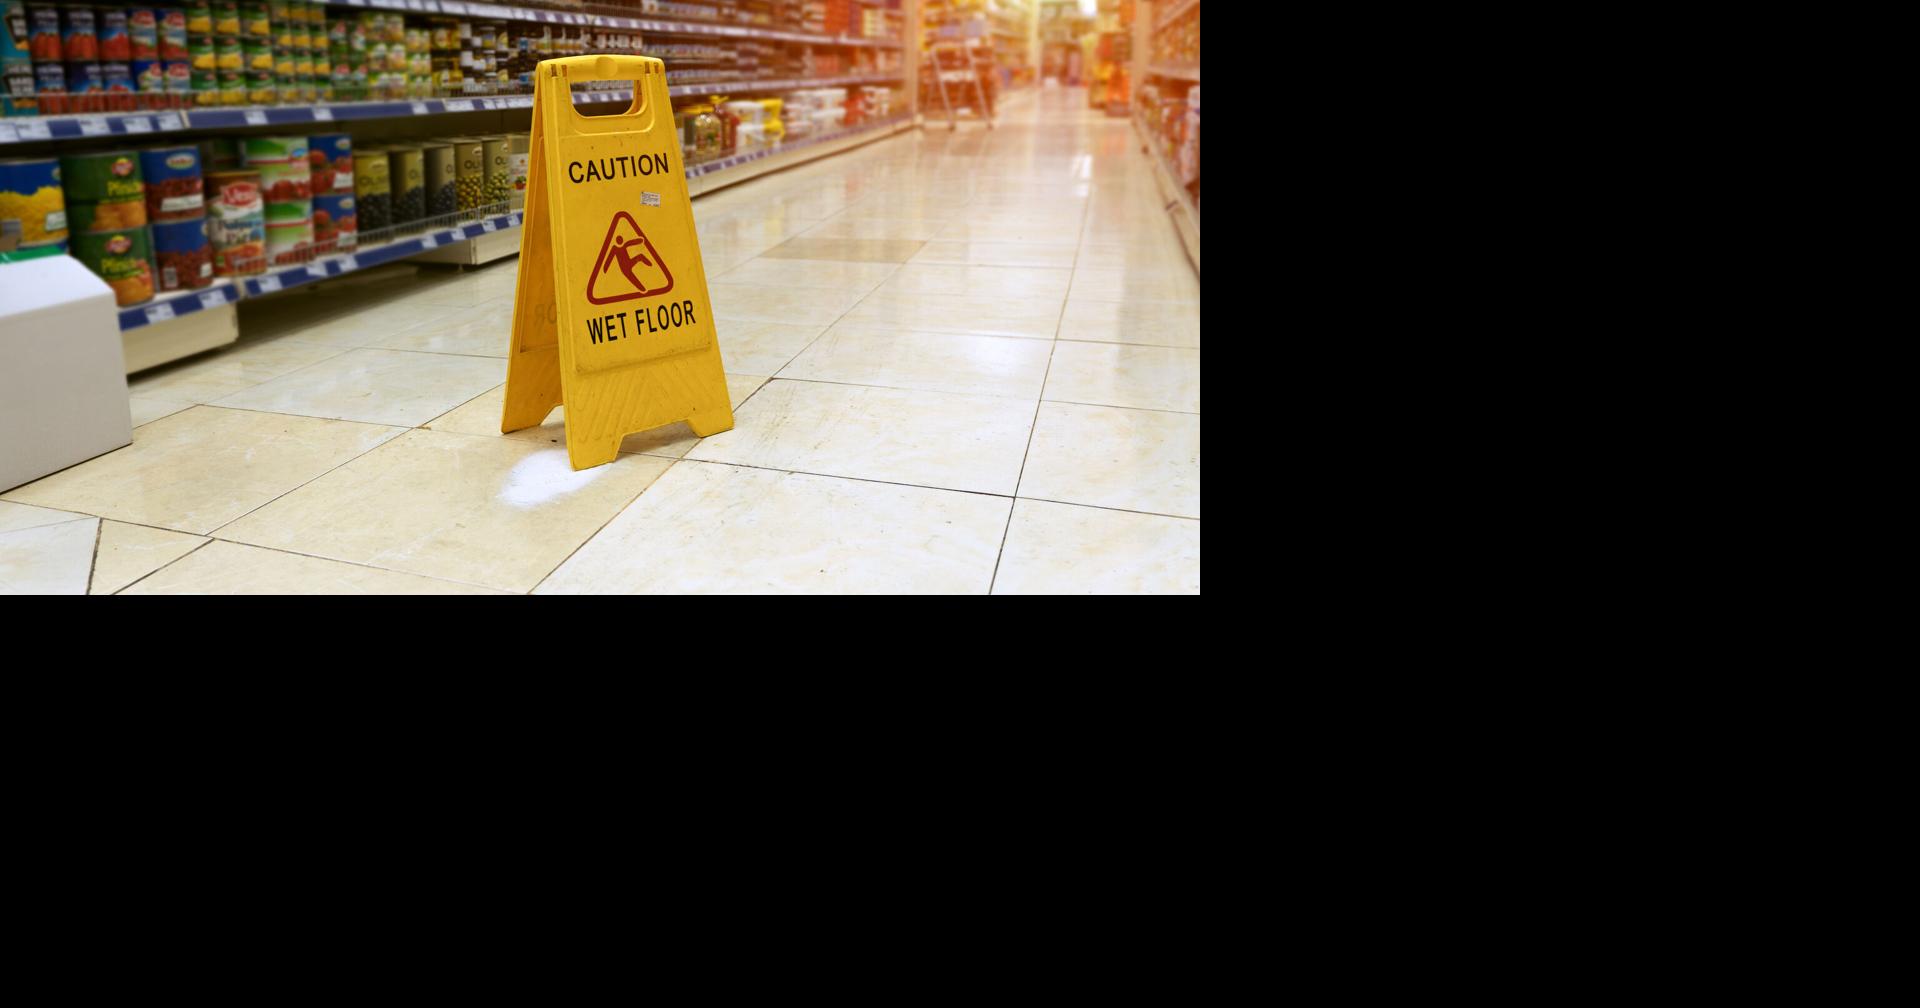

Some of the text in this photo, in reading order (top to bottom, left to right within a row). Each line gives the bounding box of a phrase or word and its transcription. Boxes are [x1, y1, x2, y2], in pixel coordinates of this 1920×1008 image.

[568, 152, 669, 184] CAUTION
[586, 312, 627, 345] WET
[634, 300, 696, 336] FLOOR
